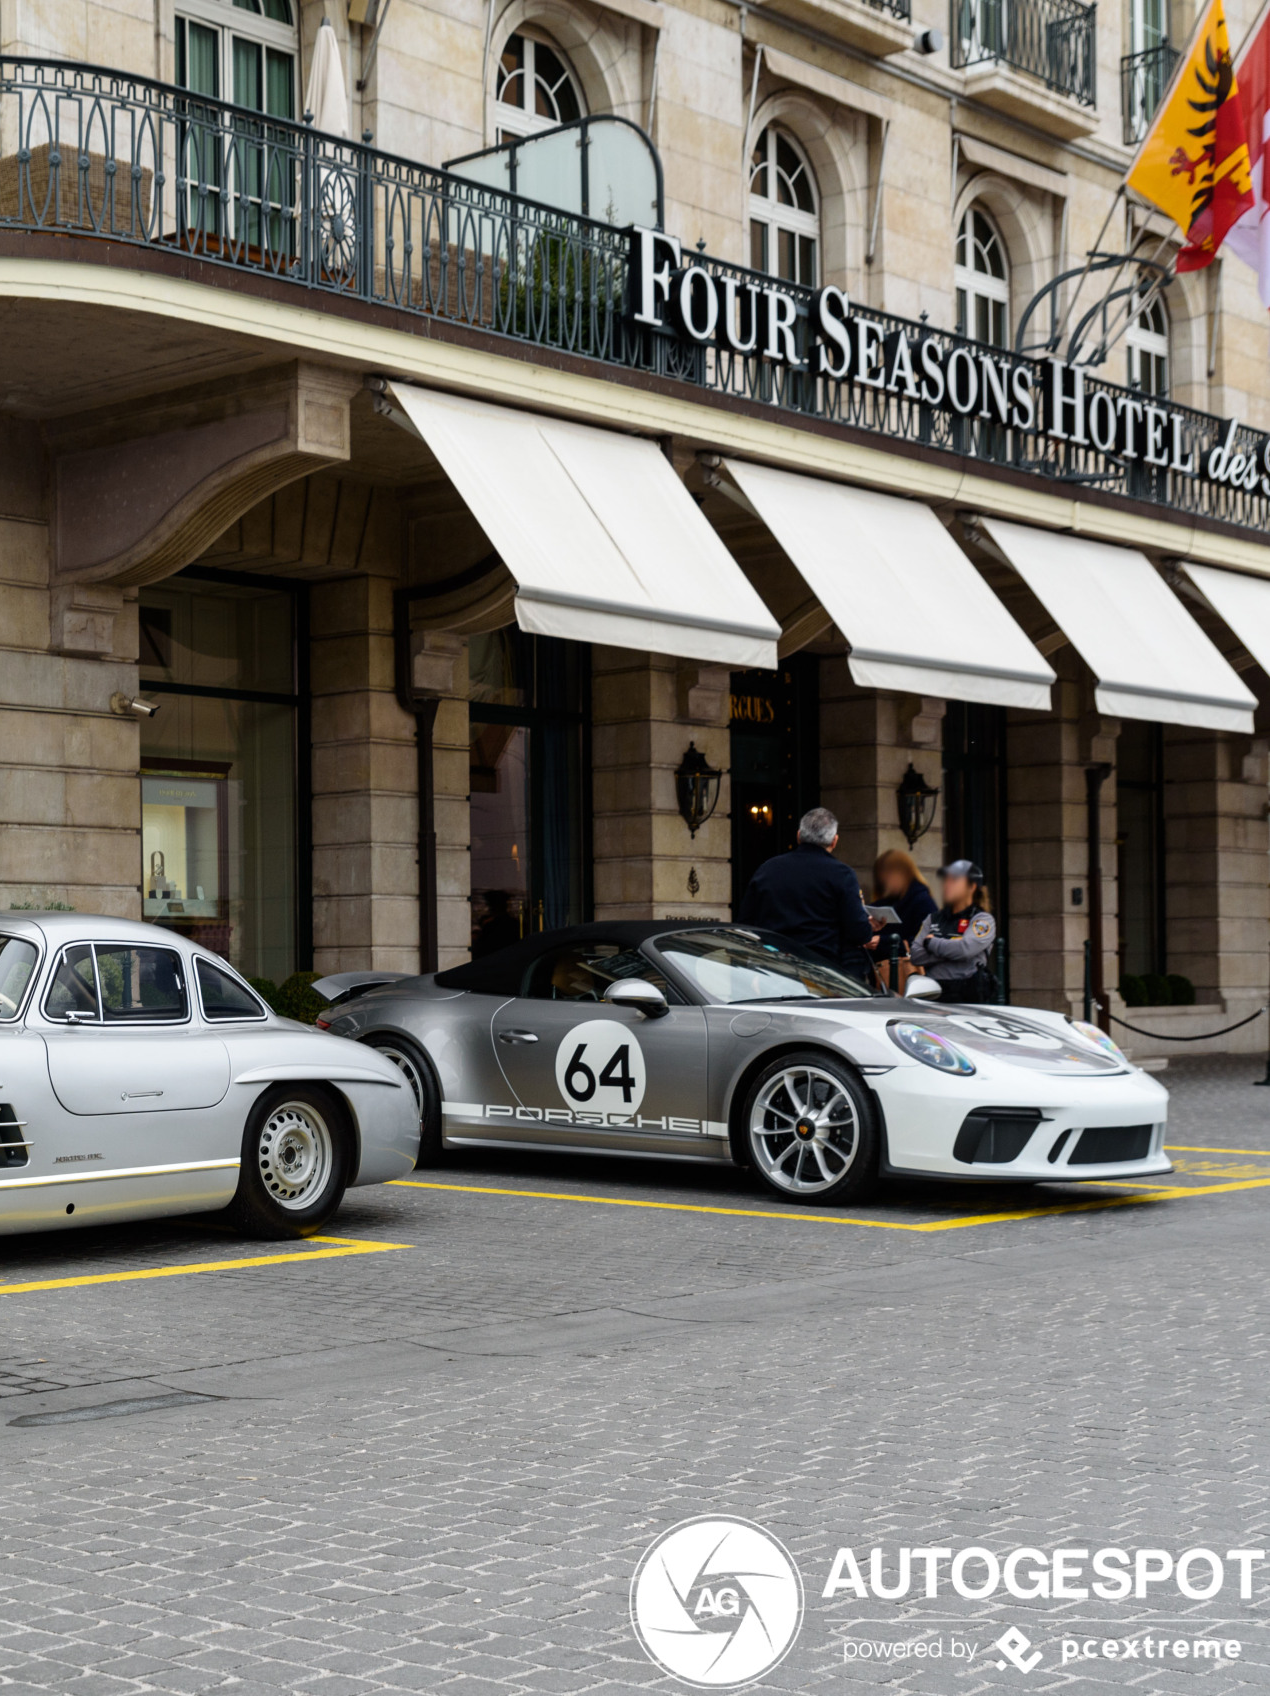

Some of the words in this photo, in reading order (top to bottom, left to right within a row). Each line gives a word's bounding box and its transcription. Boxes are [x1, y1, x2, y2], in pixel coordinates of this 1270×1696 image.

[632, 224, 802, 365] FOUR
[819, 284, 1034, 429] SEASONS
[1047, 358, 1194, 473] HOTEL
[1209, 417, 1260, 490] des
[964, 1019, 1050, 1041] 64
[564, 1043, 636, 1103] 64
[484, 1104, 701, 1134] PORSCHE
